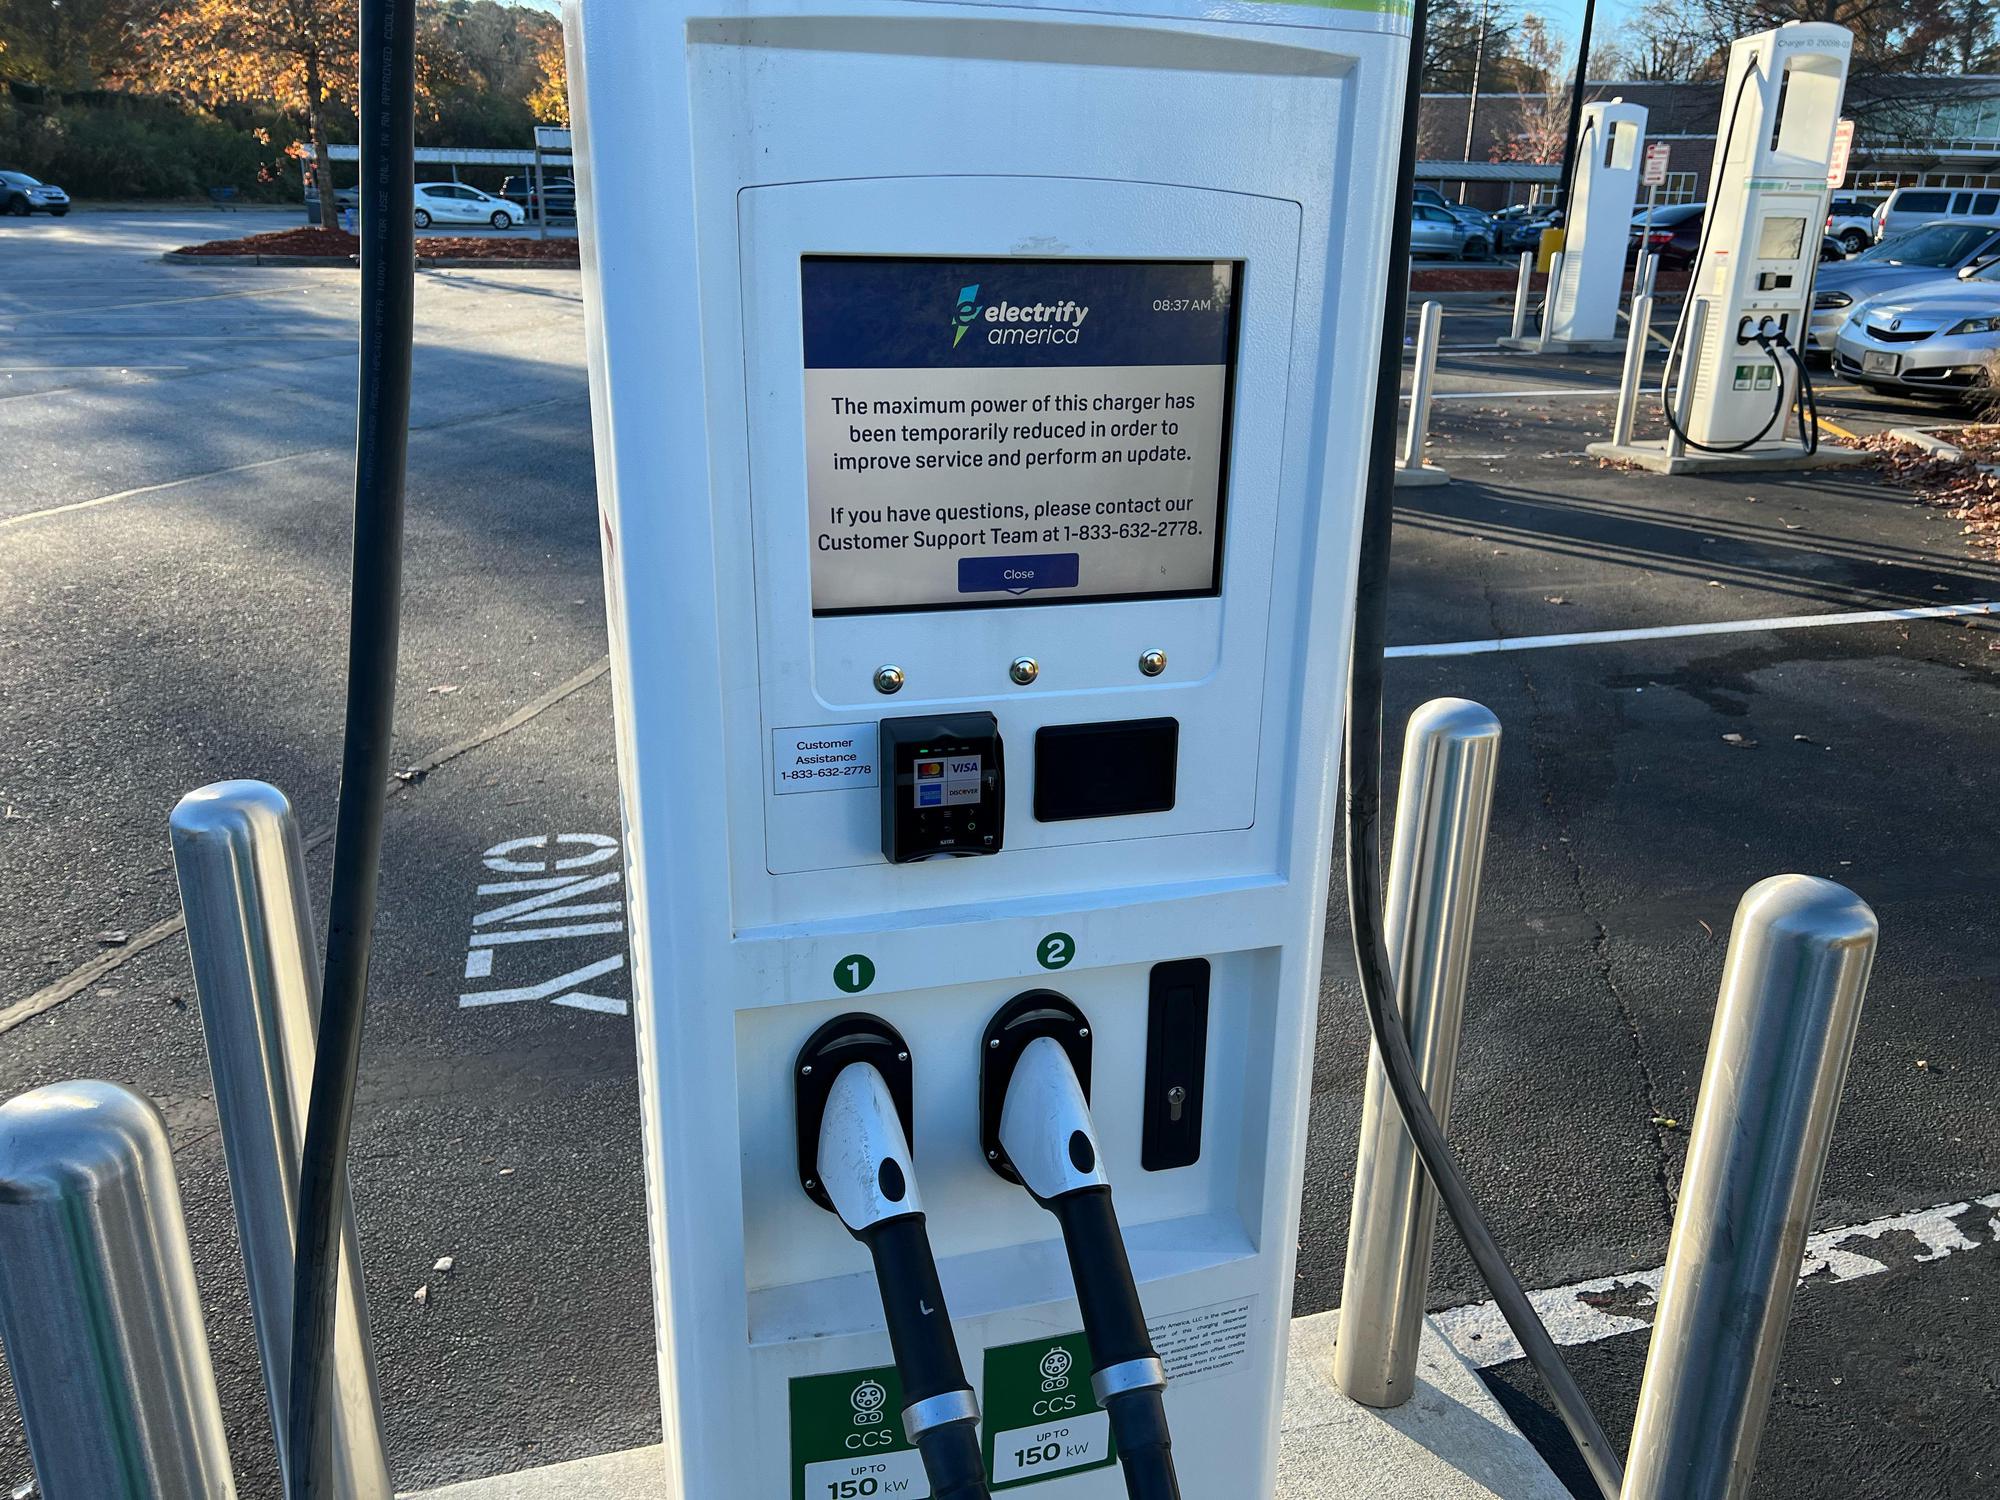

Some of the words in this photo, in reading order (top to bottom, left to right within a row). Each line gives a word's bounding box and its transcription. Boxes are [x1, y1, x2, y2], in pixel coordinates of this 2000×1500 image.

[381, 46, 392, 105] APPROVED
[380, 112, 391, 126] AN
[379, 156, 390, 184] ONLY
[378, 191, 389, 212] USE
[377, 218, 388, 240] FOR
[985, 301, 1088, 326] electrify
[1153, 299, 1188, 311] 08:37
[1192, 299, 1211, 311] AM
[988, 325, 1079, 344] america
[832, 397, 868, 414] The
[874, 397, 964, 414] maximum
[970, 398, 1028, 416] power
[1032, 394, 1051, 412] of
[1055, 394, 1088, 412] this
[1092, 394, 1160, 414] charger
[1165, 392, 1195, 410] has
[850, 425, 896, 442] been
[901, 422, 1008, 445] temporarily
[1013, 421, 1086, 440] reduced
[1091, 421, 1106, 438] in
[1110, 420, 1156, 438] order
[1162, 420, 1178, 436] to
[833, 452, 911, 472] improve
[915, 450, 982, 469] service
[987, 450, 1020, 468] and
[1025, 448, 1097, 469] perform
[1101, 449, 1122, 464] an
[1127, 446, 1192, 466] update.
[830, 506, 845, 524] If
[848, 509, 882, 528] you
[886, 505, 932, 523] have
[935, 502, 1030, 526] questions,
[1034, 500, 1091, 521] please
[1095, 498, 1161, 516] contact
[1165, 496, 1194, 512] our
[818, 532, 909, 551] Customer
[914, 529, 986, 551] Support
[990, 527, 1038, 545] Team
[1042, 526, 1060, 542] at
[1064, 520, 1203, 543] 1-833-632-2778.
[1004, 568, 1034, 580] Close
[796, 738, 854, 752] Customer
[796, 751, 857, 766] Assistance
[952, 762, 978, 772] VISA
[781, 764, 872, 781] 1-833-632-2778
[459, 833, 627, 1015] ONLY
[1047, 938, 1066, 963] 2
[846, 962, 859, 986] 1
[1197, 1322, 1218, 1331] charging
[1225, 1332, 1246, 1341] charging
[1032, 1394, 1076, 1417] CCS
[844, 1429, 893, 1451] CCS
[1036, 1432, 1051, 1443] UP
[1052, 1428, 1069, 1440] TO
[1014, 1443, 1060, 1468] 150
[1066, 1442, 1089, 1458] kW
[850, 1466, 866, 1476] UP
[867, 1464, 886, 1475] TO
[827, 1477, 878, 1500] 150
[884, 1478, 910, 1494] kW
